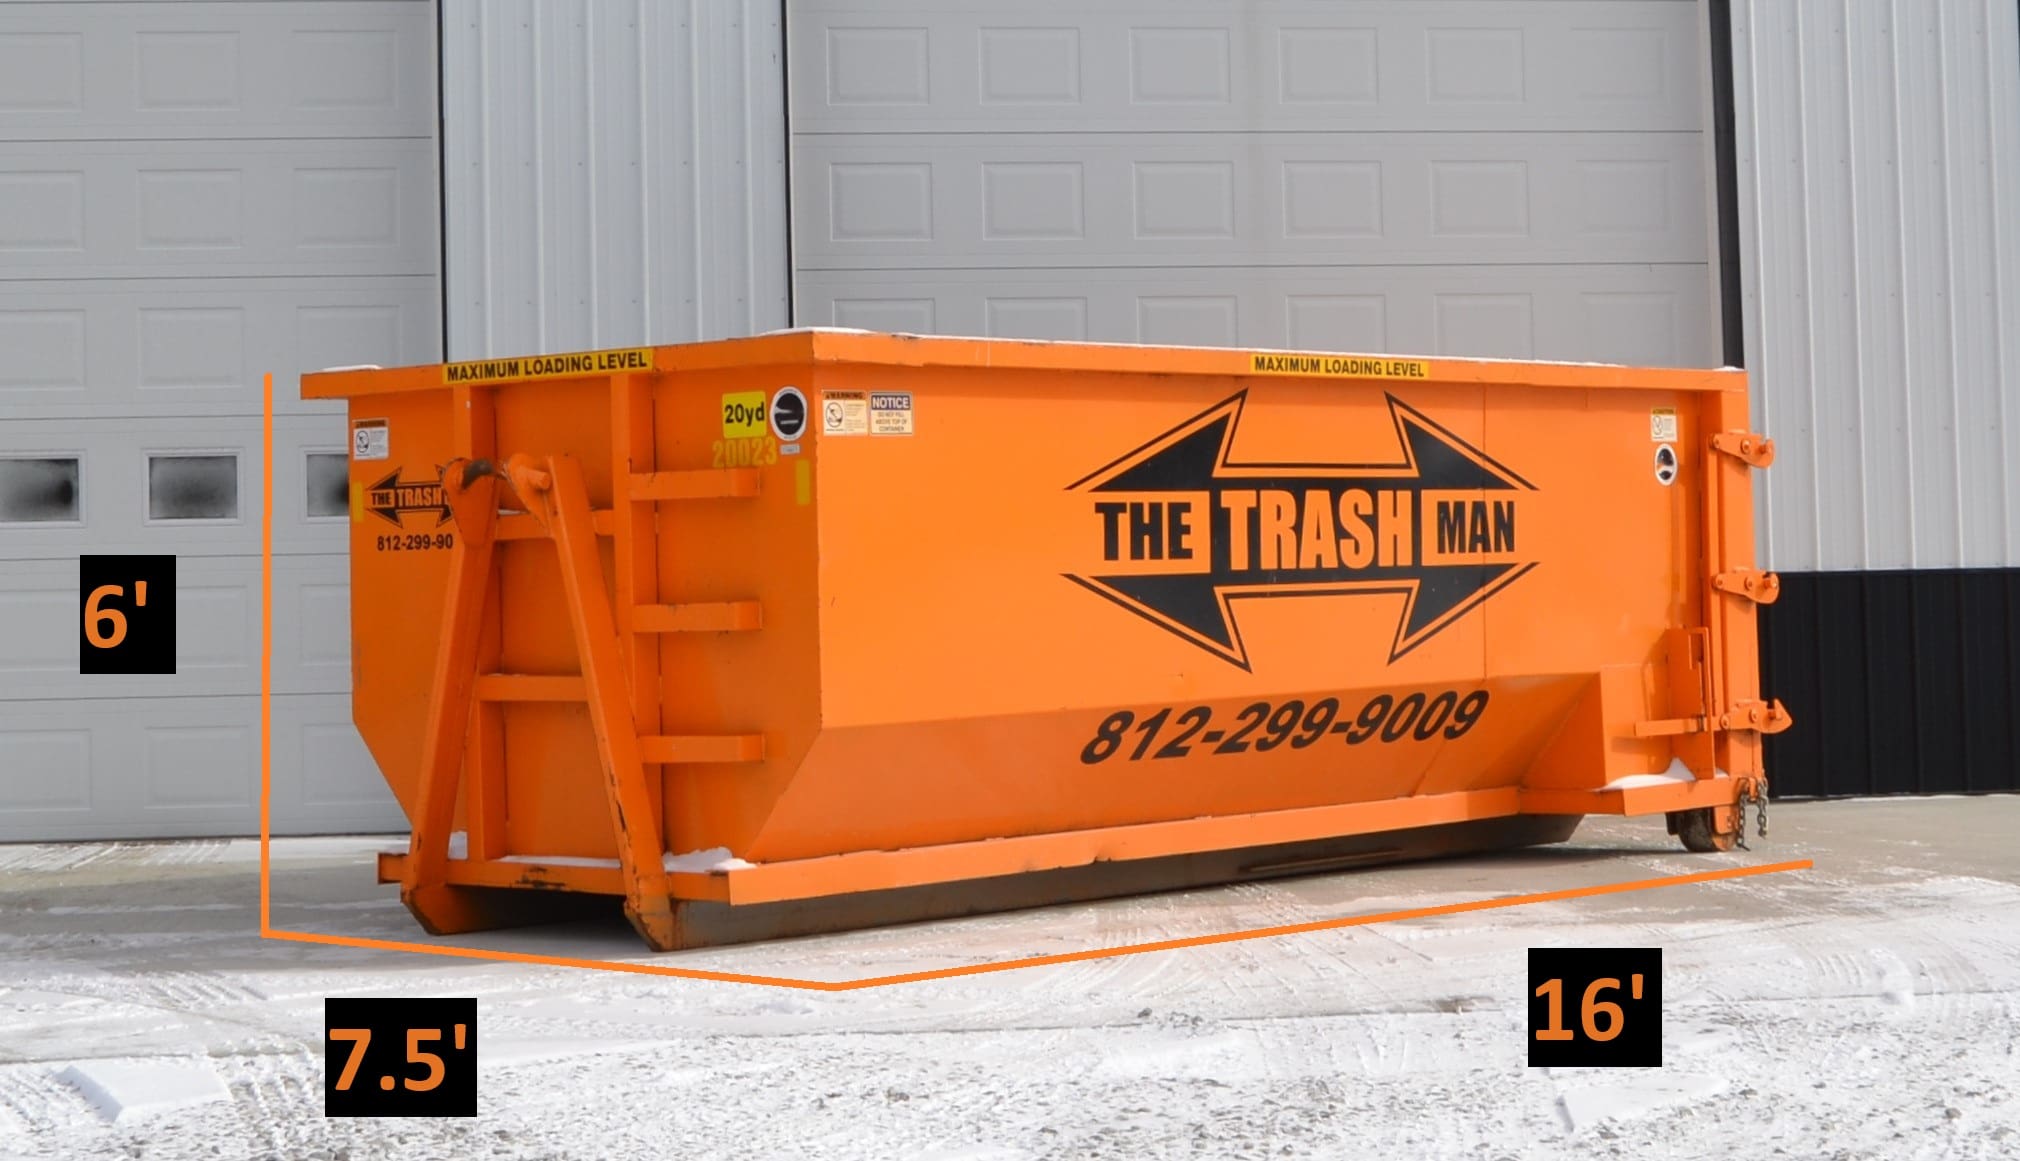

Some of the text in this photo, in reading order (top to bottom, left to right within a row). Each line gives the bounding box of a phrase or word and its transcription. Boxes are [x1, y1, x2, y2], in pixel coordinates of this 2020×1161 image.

[447, 352, 647, 381] MAXIMUM LOADING LEVEL
[1255, 356, 1424, 377] MAXIMUM LOADING LEVEL
[725, 401, 765, 427] 20yd
[872, 396, 909, 409] NOTICE
[712, 436, 777, 468] 20023
[371, 487, 442, 507] THE TRASH
[377, 533, 453, 551] 812-299-90
[1095, 488, 1515, 571] THE TRASH MAN
[1080, 690, 1490, 765] 812-299-9009
